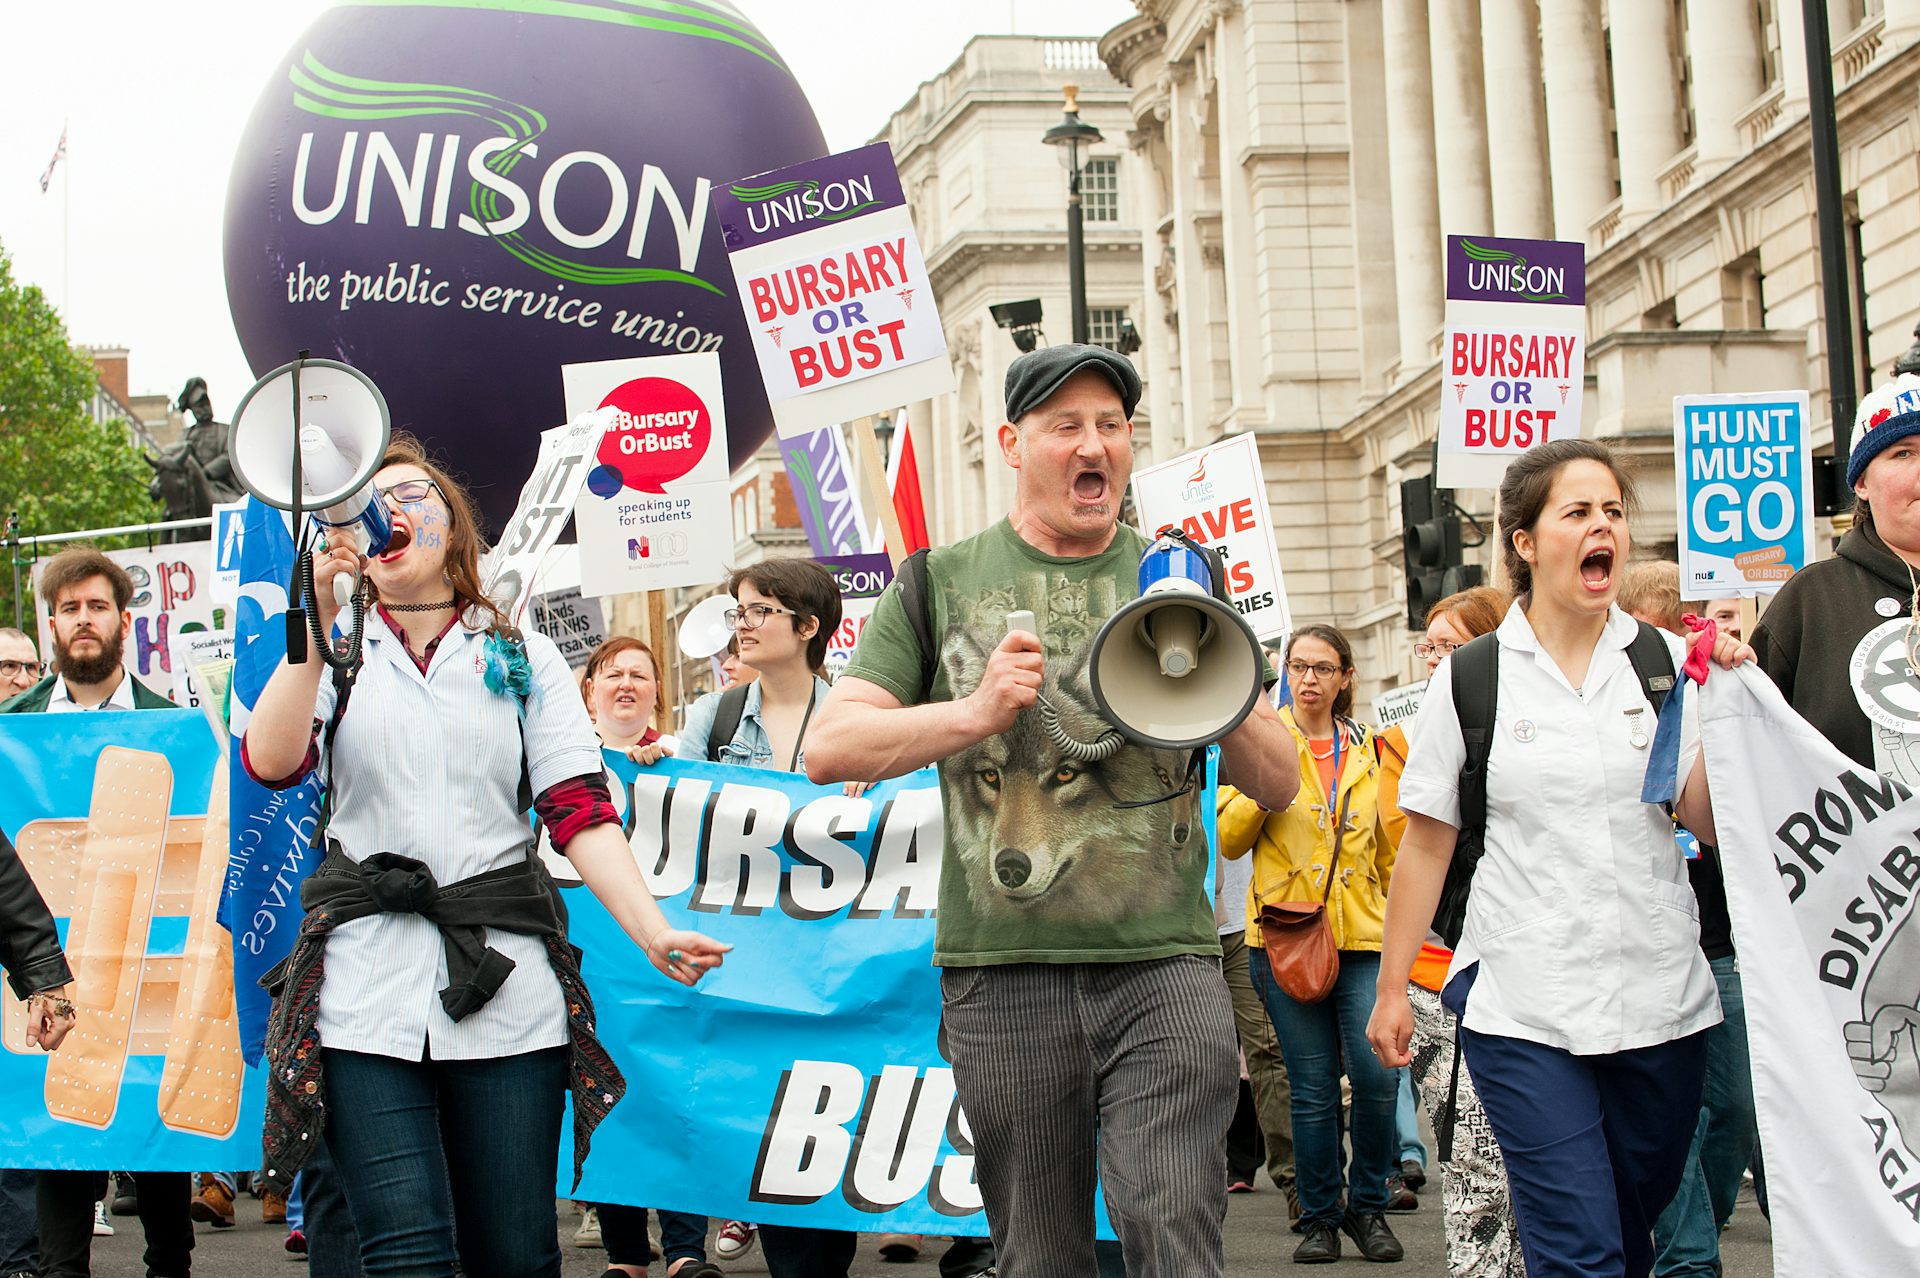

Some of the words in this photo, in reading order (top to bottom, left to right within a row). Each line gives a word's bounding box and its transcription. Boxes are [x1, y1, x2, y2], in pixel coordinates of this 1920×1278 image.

[290, 130, 712, 273] UNISON
[746, 174, 874, 233] UNISON
[748, 237, 909, 324] BURSARY
[1467, 262, 1565, 294] UNISON
[286, 260, 331, 304] the
[340, 261, 451, 311] public
[461, 283, 602, 328] service
[610, 309, 724, 353] union
[811, 300, 869, 335] OR
[789, 319, 906, 389] BUST
[1451, 332, 1577, 379] BURSARY
[1490, 381, 1533, 405] OR
[619, 431, 693, 455] OrBust
[1464, 408, 1557, 449] BUST
[1690, 409, 1794, 445] HUNT
[1692, 445, 1795, 481] MUST
[618, 499, 672, 516] speaking
[676, 498, 691, 511] up
[619, 515, 637, 527] for
[640, 510, 692, 525] students
[1692, 480, 1795, 544] GO
[124, 560, 197, 613] ep
[1695, 570, 1715, 580] nus
[563, 614, 590, 636] NHS
[191, 639, 222, 650] Socialist
[1854, 627, 1887, 668] Disabled
[1378, 698, 1419, 723] Hands
[1867, 704, 1906, 729] Against
[1819, 826, 1920, 991] DISAB
[1859, 1114, 1920, 1224] AGA
